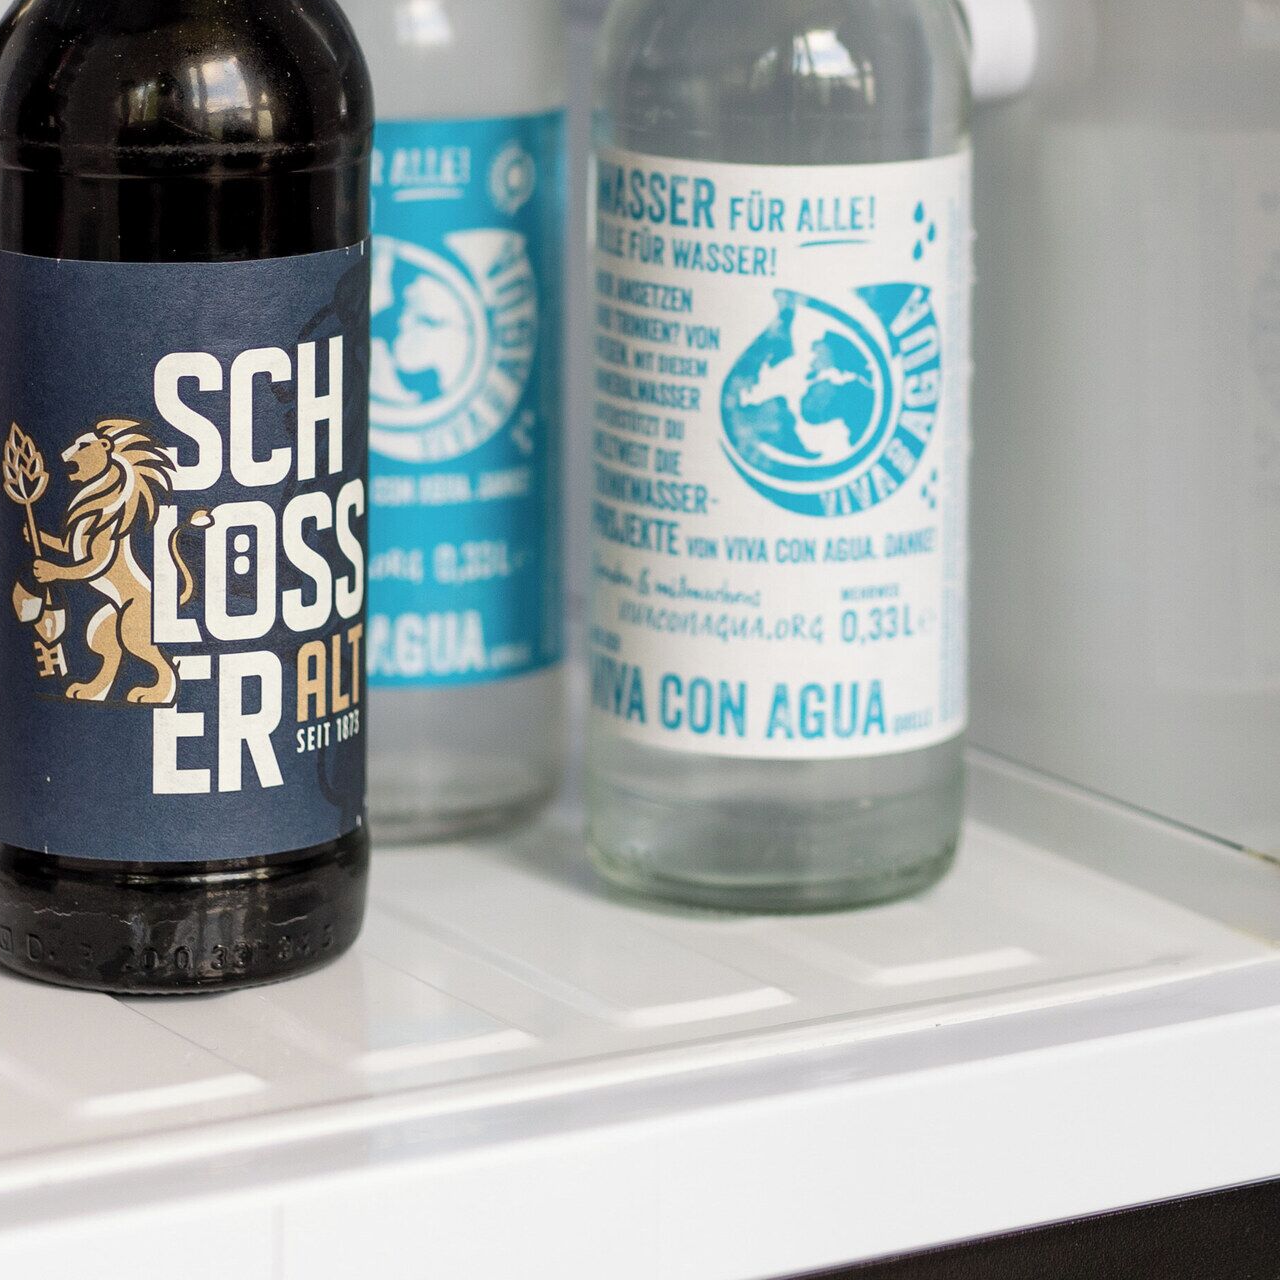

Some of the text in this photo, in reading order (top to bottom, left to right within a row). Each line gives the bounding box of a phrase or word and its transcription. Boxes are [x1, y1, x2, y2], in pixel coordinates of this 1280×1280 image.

[729, 190, 786, 232] FÜR
[797, 196, 876, 233] ALLE!
[671, 238, 777, 277] WASSER!
[152, 335, 344, 491] SCH
[724, 536, 768, 563] VIVA
[775, 537, 817, 565] CON
[152, 623, 363, 795] ER ALT
[659, 672, 747, 737] CON
[766, 678, 886, 741] AGUA
[296, 708, 360, 754] SEIT 1873
